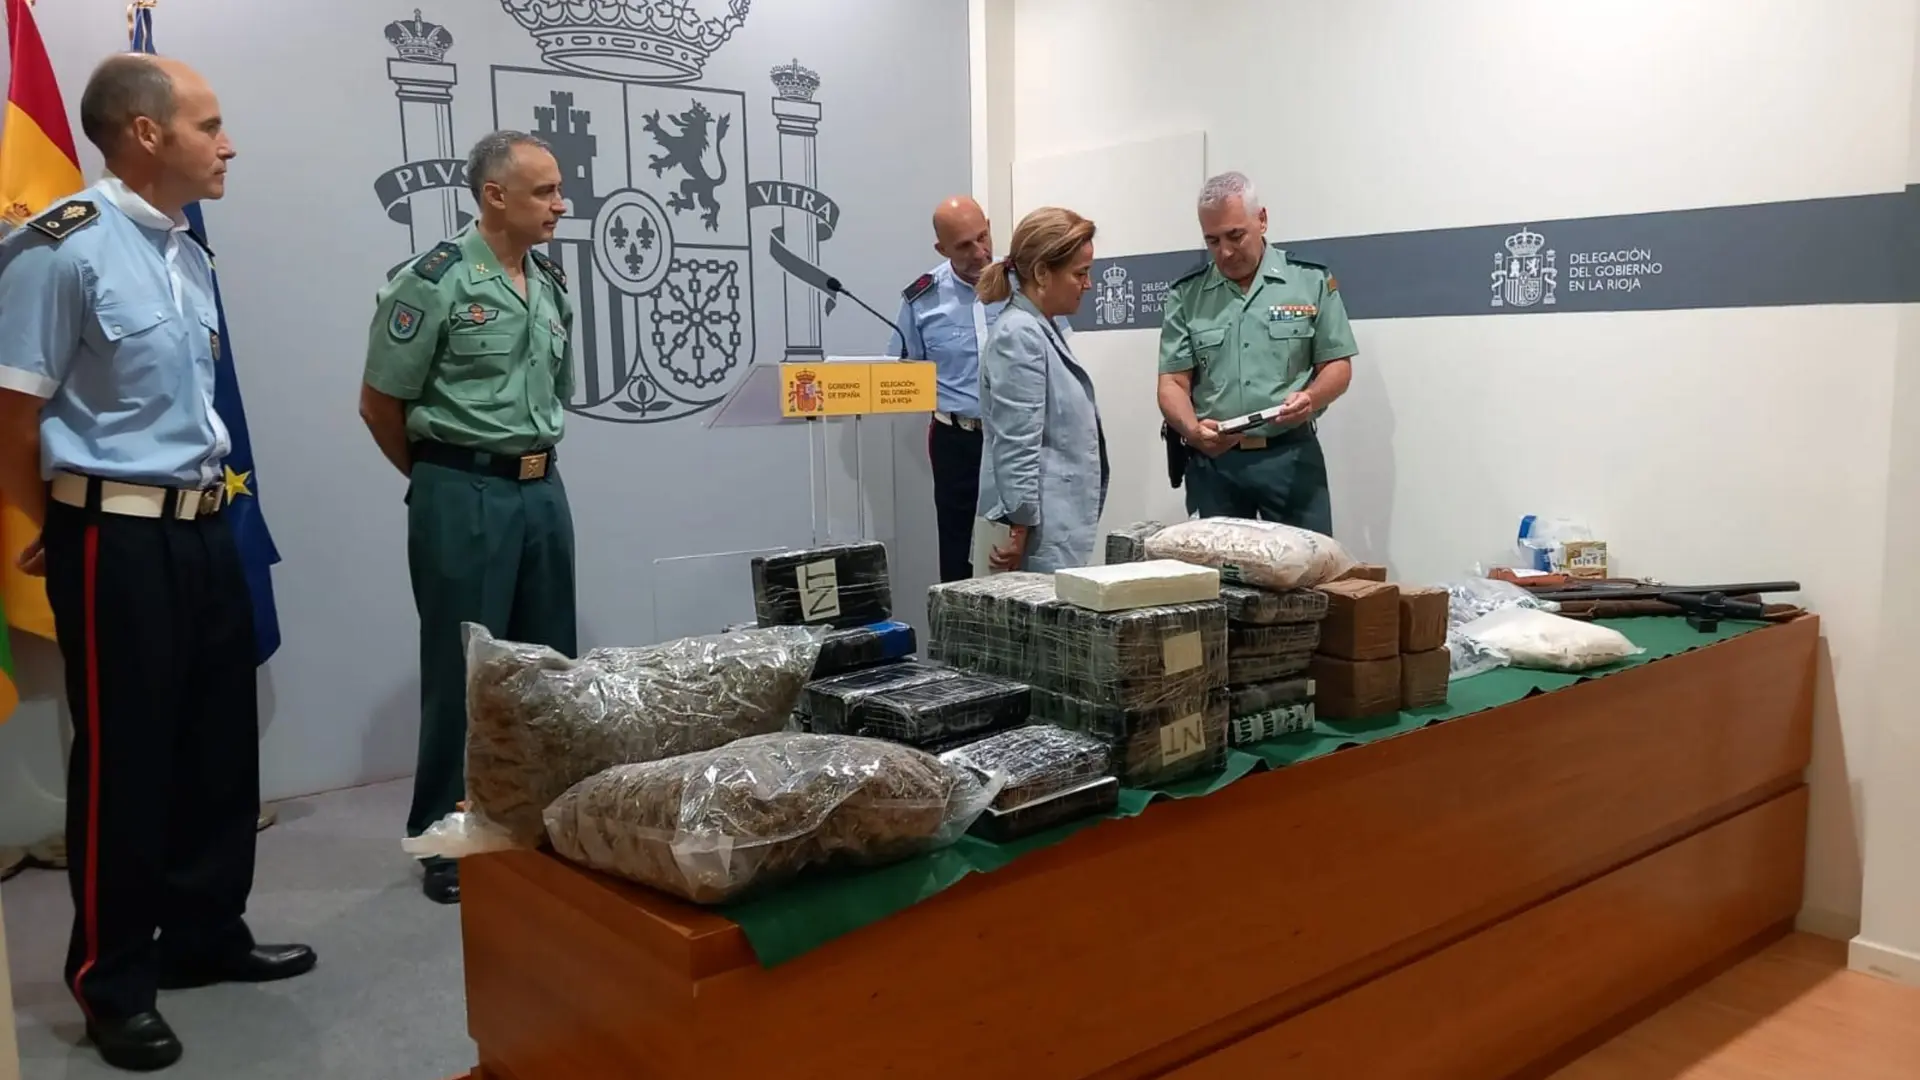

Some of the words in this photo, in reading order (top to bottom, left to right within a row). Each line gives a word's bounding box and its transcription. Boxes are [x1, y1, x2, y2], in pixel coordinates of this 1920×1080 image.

[756, 184, 832, 223] VLTRA
[1569, 247, 1651, 264] DELEGACIÓN
[1569, 266, 1591, 278] DEL
[1595, 262, 1663, 277] GOBIERNO
[1141, 281, 1169, 292] DELEGA
[1569, 280, 1585, 292] EN
[1588, 279, 1604, 291] LA
[1607, 278, 1641, 292] RIOJA
[1141, 293, 1155, 302] DEL
[1141, 304, 1152, 312] EN
[1153, 303, 1163, 312] LA
[827, 382, 860, 390] GOBIERNO
[880, 380, 915, 388] DELEGACIÓN
[838, 390, 861, 399] ESPAÑA
[892, 388, 920, 396] GOBIERNO
